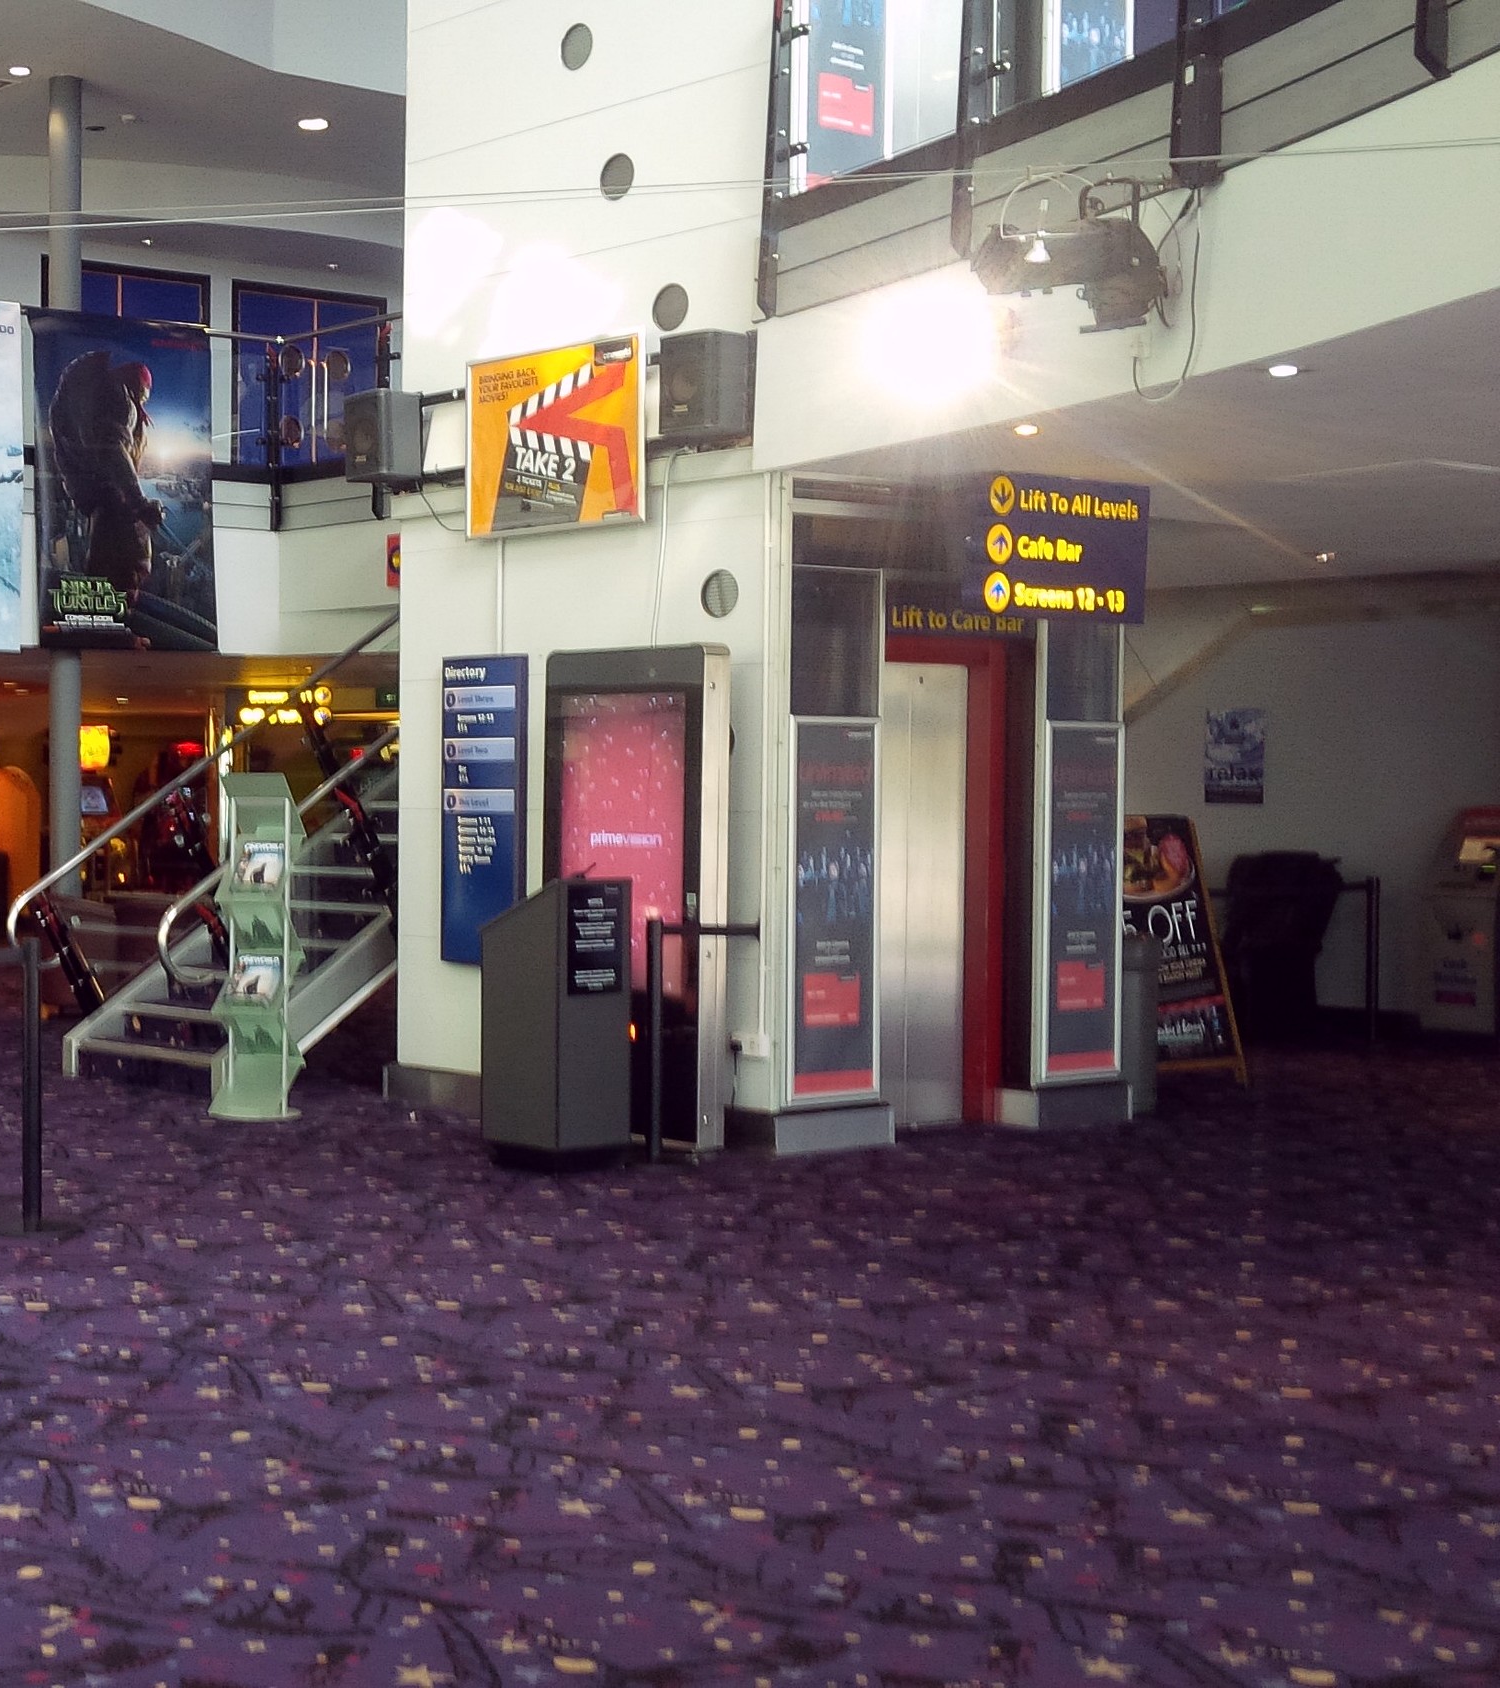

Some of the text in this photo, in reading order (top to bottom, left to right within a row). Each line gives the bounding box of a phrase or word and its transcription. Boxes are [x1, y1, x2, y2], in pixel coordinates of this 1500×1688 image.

[515, 446, 576, 482] TAKE 2
[1020, 489, 1139, 521] Lift To All Levels
[1017, 536, 1083, 563] Cafe Bar
[61, 579, 115, 595] NINJA
[1014, 582, 1074, 610] Screens
[47, 589, 128, 616] TURTLES
[892, 606, 923, 629] Lift
[928, 608, 947, 630] to
[445, 666, 486, 681] Directory
[1148, 899, 1198, 946] OFF
